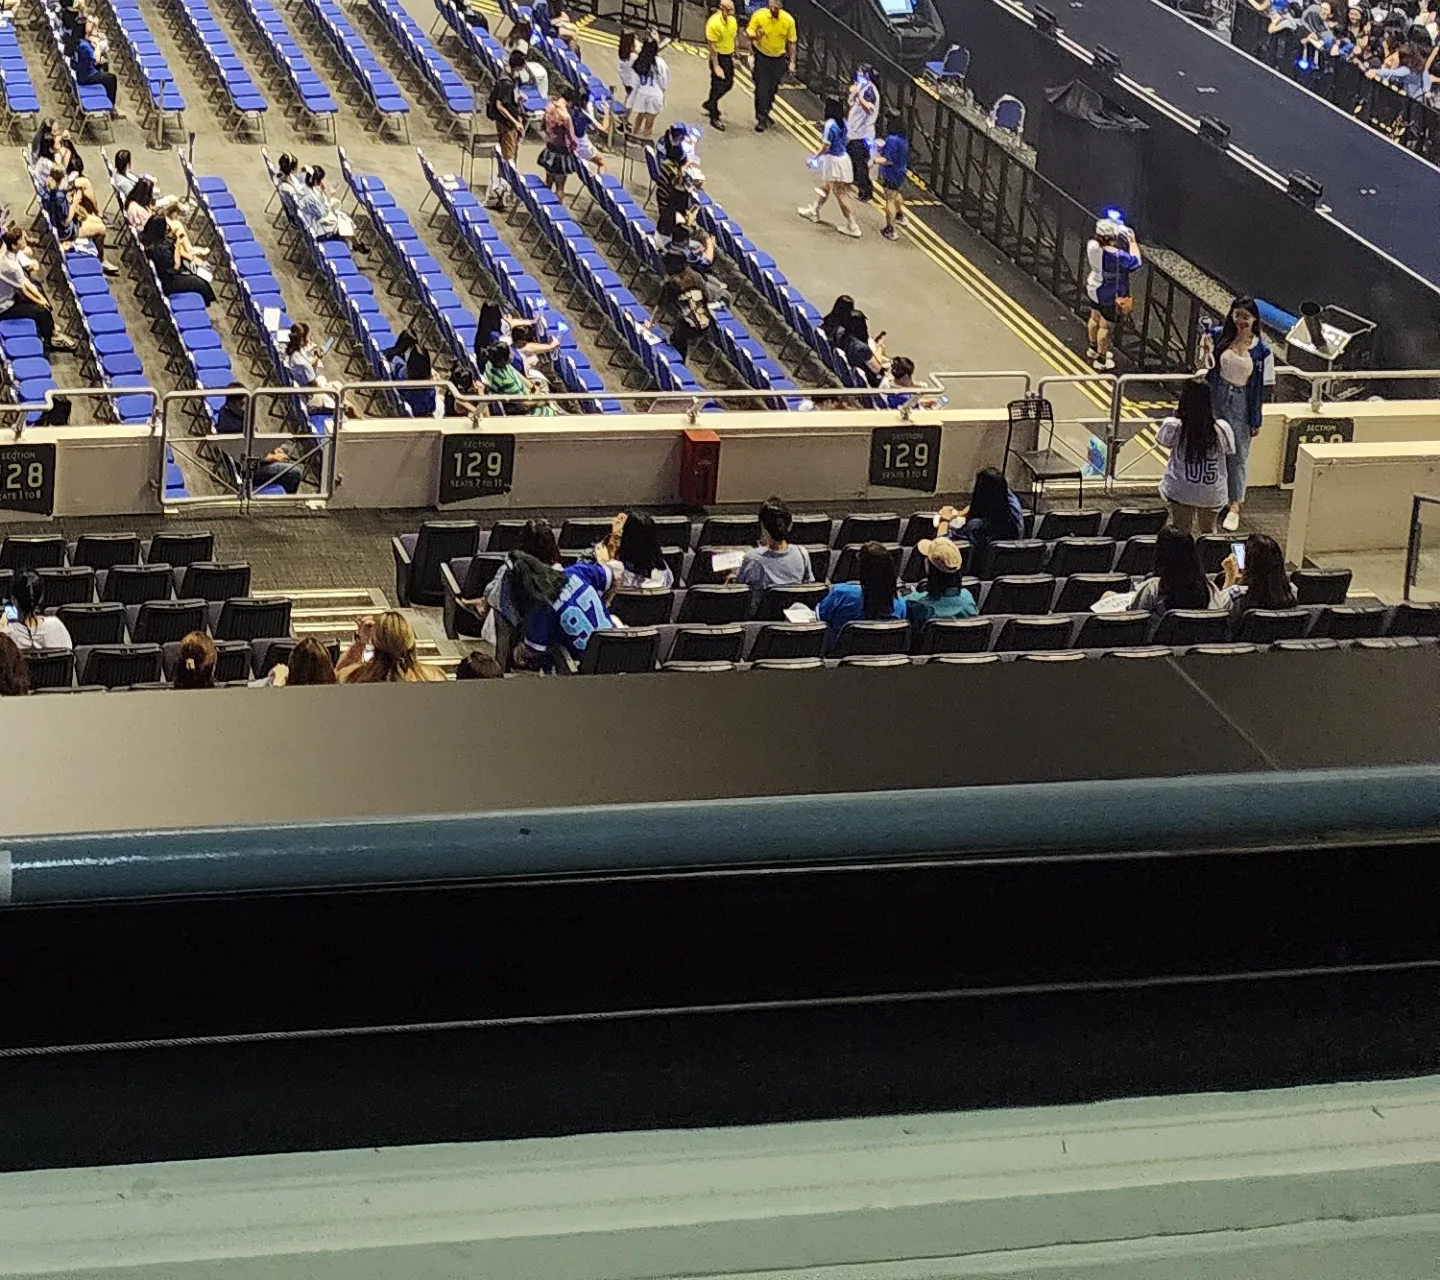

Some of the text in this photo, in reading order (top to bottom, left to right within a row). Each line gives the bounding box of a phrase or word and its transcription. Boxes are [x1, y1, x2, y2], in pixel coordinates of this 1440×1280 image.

[1306, 424, 1337, 433] SECTION
[1, 451, 36, 460] SECTION
[453, 452, 502, 478] 129
[882, 443, 929, 469] 129
[560, 585, 613, 650] 97
